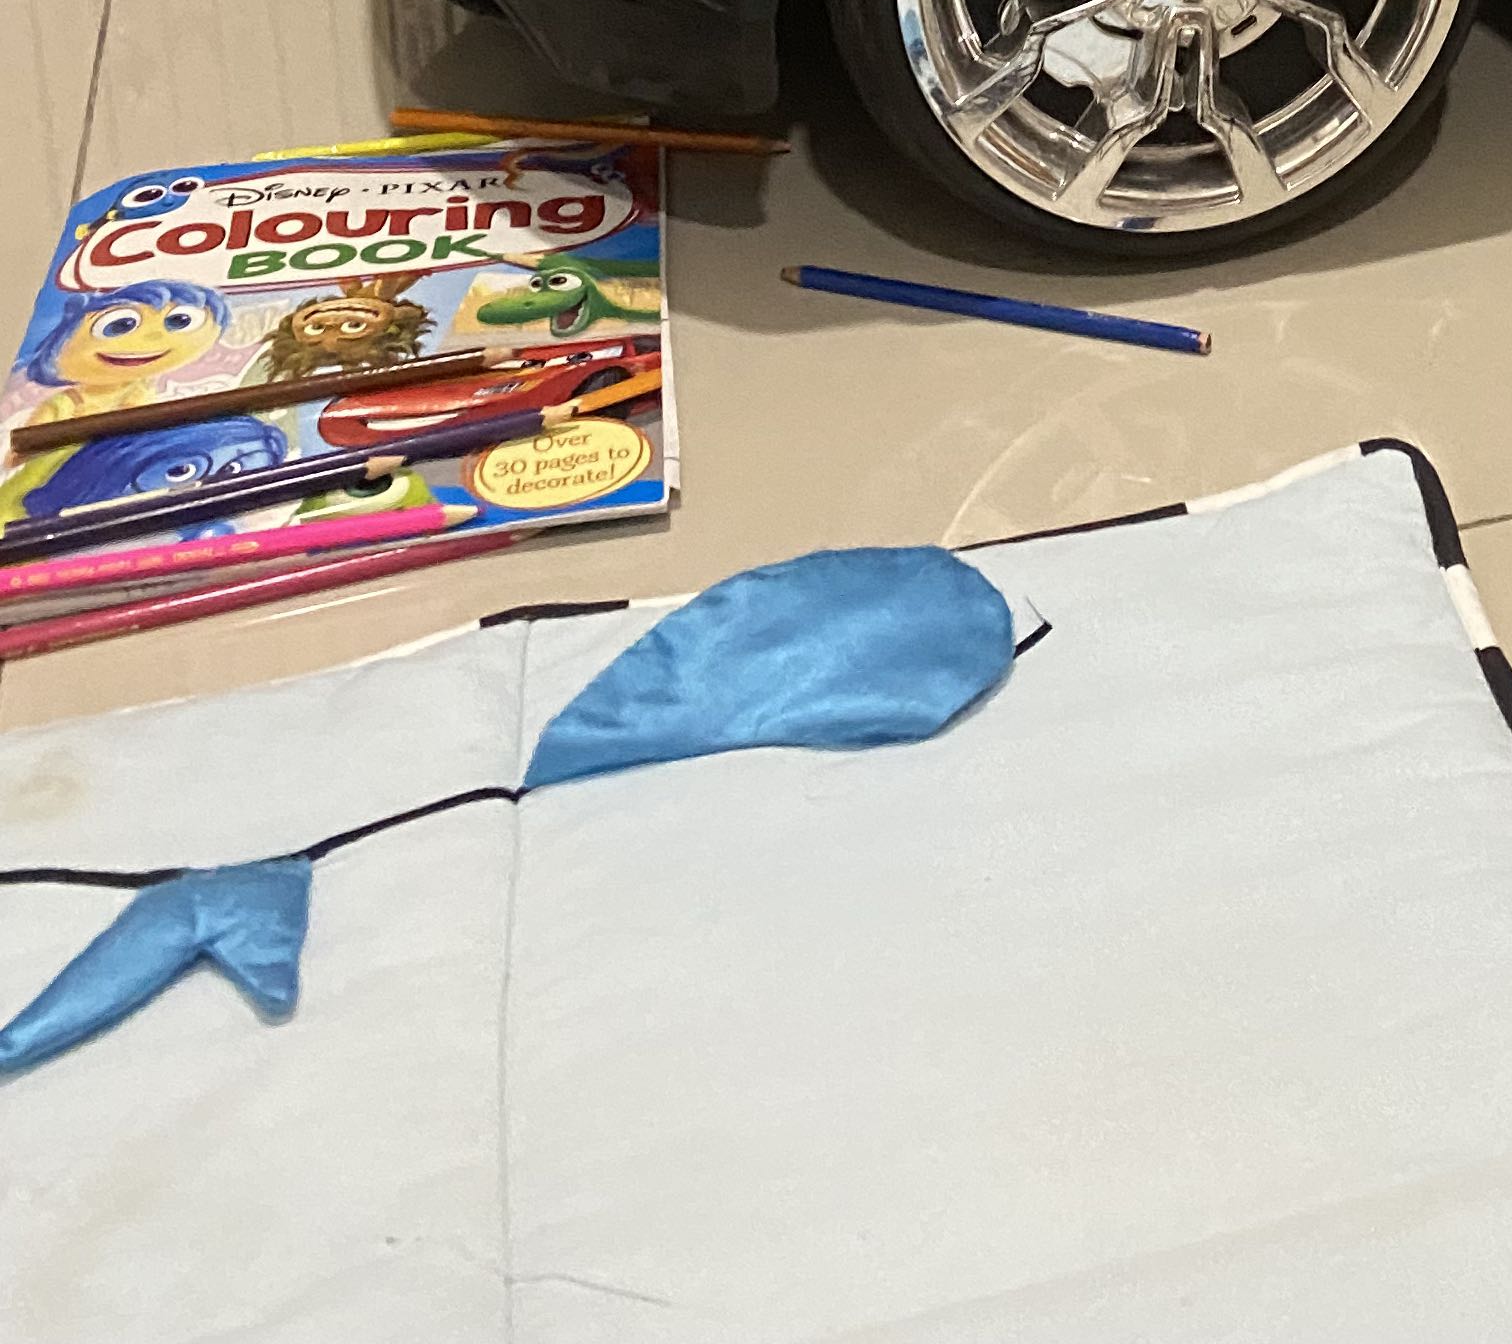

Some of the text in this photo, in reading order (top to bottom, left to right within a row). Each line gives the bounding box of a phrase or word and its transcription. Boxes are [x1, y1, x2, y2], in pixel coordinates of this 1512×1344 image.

[381, 173, 500, 196] PIXAR
[89, 190, 605, 268] Colouring
[226, 232, 491, 281] BOOK
[531, 430, 593, 454] Over
[491, 445, 631, 478] 30 pages to
[505, 466, 615, 497] decorate!
